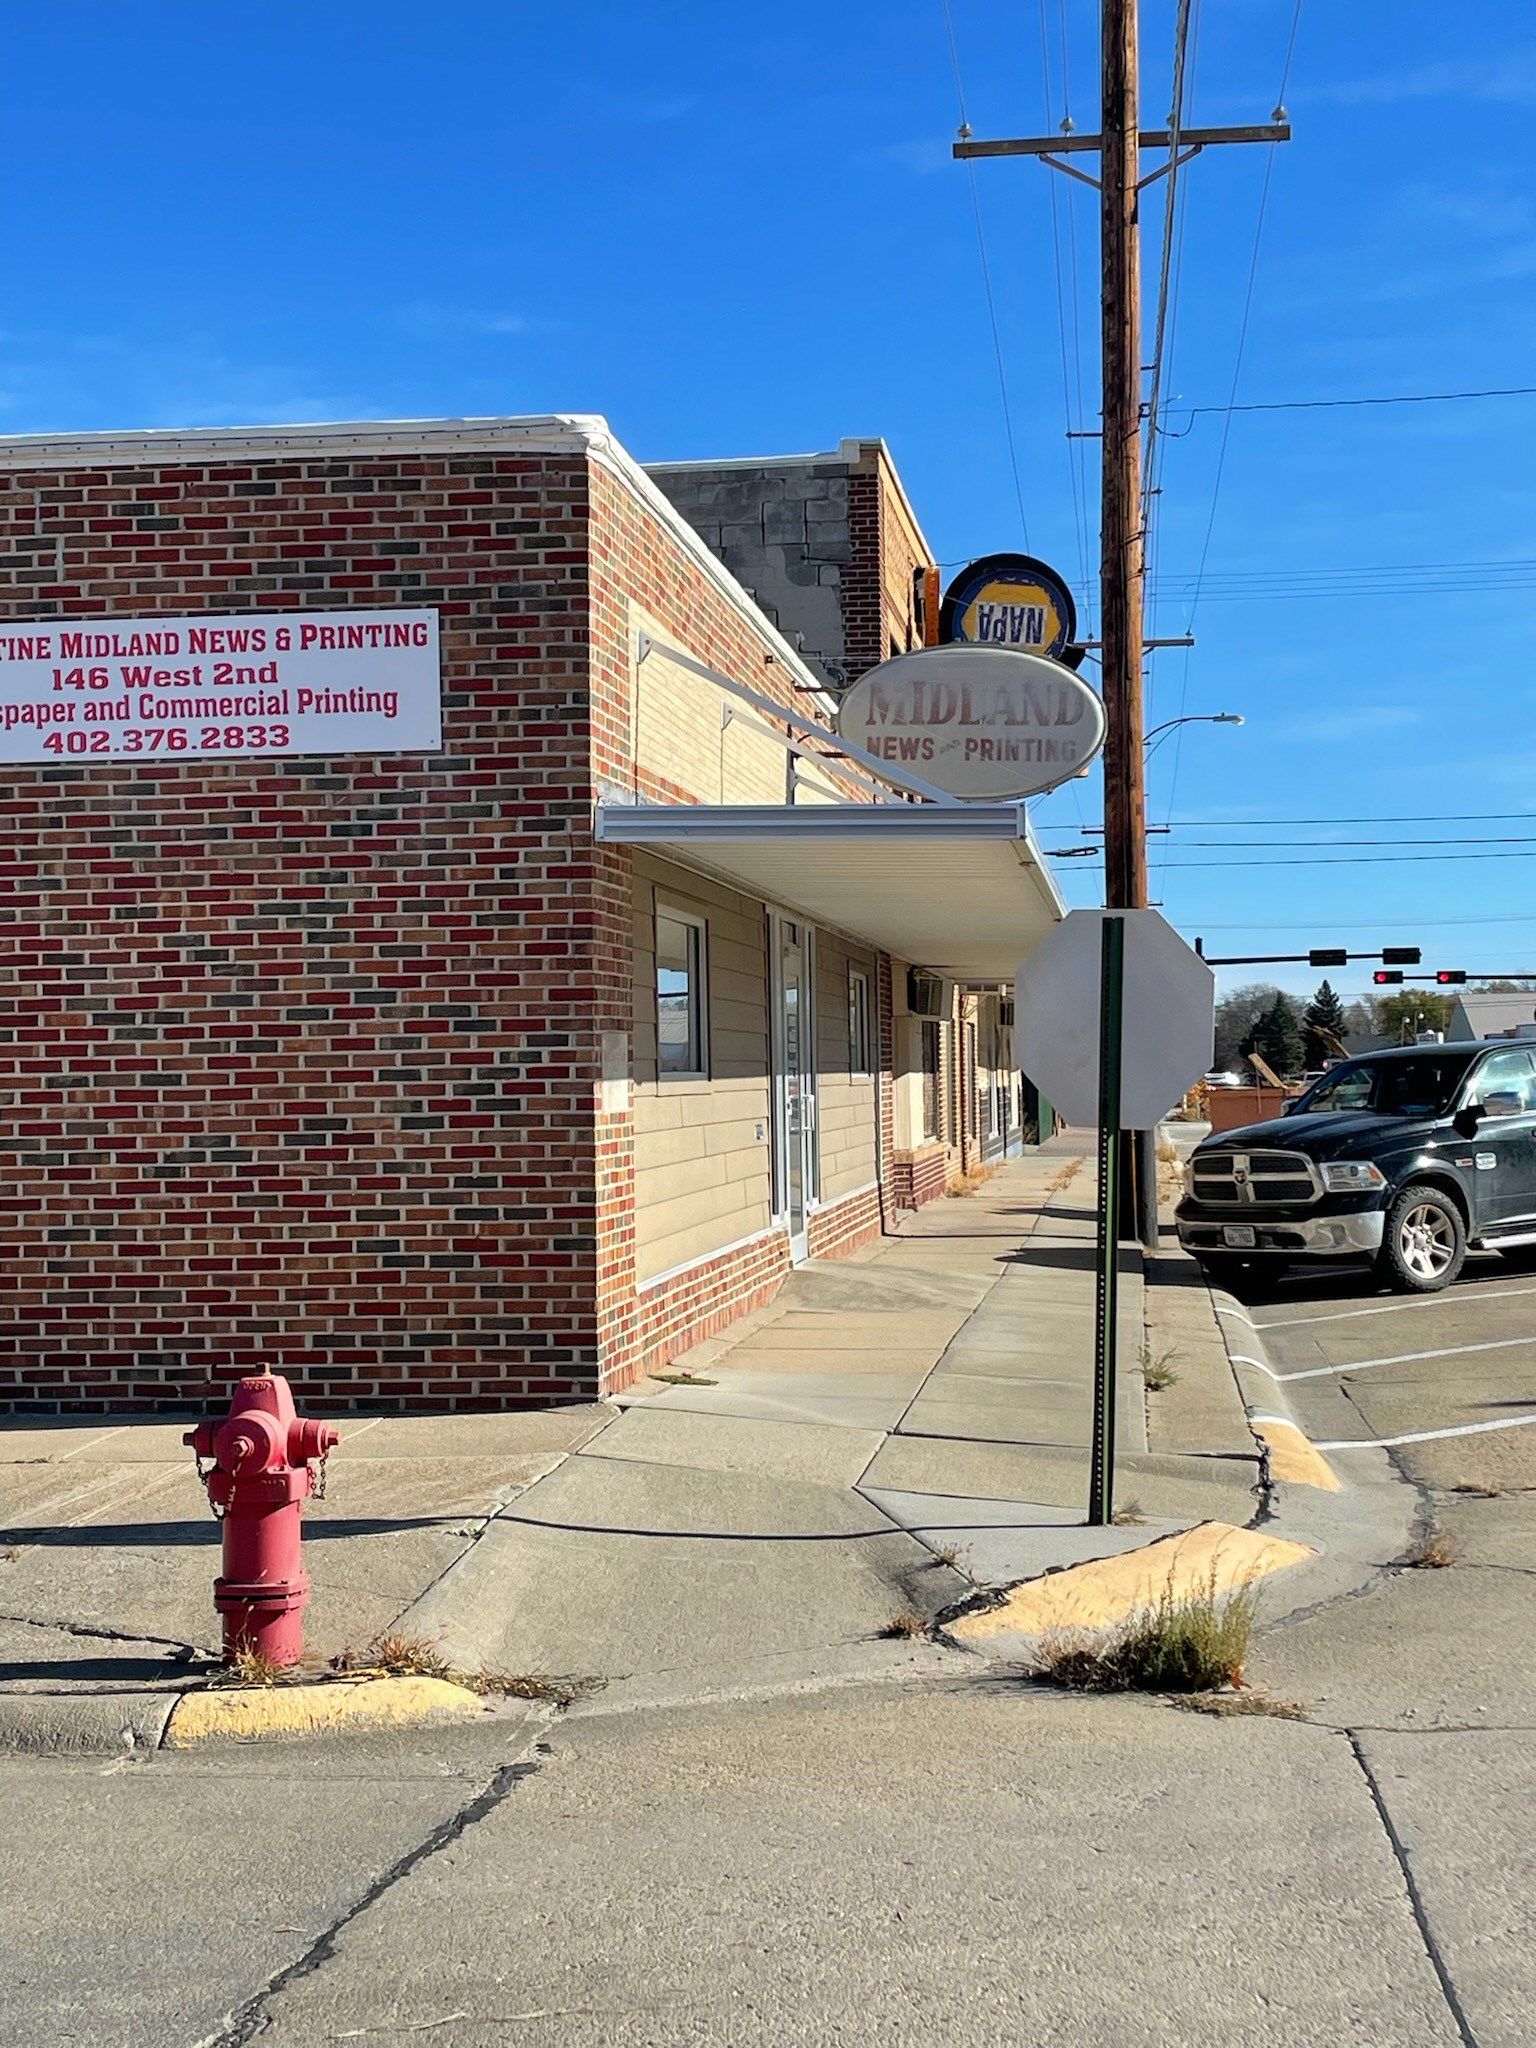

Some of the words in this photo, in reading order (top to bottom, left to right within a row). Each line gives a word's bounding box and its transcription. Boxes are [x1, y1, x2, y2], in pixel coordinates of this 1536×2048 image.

[60, 632, 180, 659] MIDLAND
[189, 627, 267, 655] NEWS
[276, 627, 291, 651] &
[300, 622, 428, 651] PRINTING
[979, 605, 1043, 644] NAPA
[53, 667, 109, 691] 146
[120, 664, 203, 689] West
[214, 662, 279, 686] 2nd
[84, 694, 131, 722] and
[139, 689, 290, 720] Commercial
[297, 686, 399, 719] Printing
[865, 680, 1085, 727] MIDLAND
[43, 723, 290, 755] 402.376.2833
[866, 736, 935, 761] NEWS
[964, 737, 1077, 762] PRINTING
